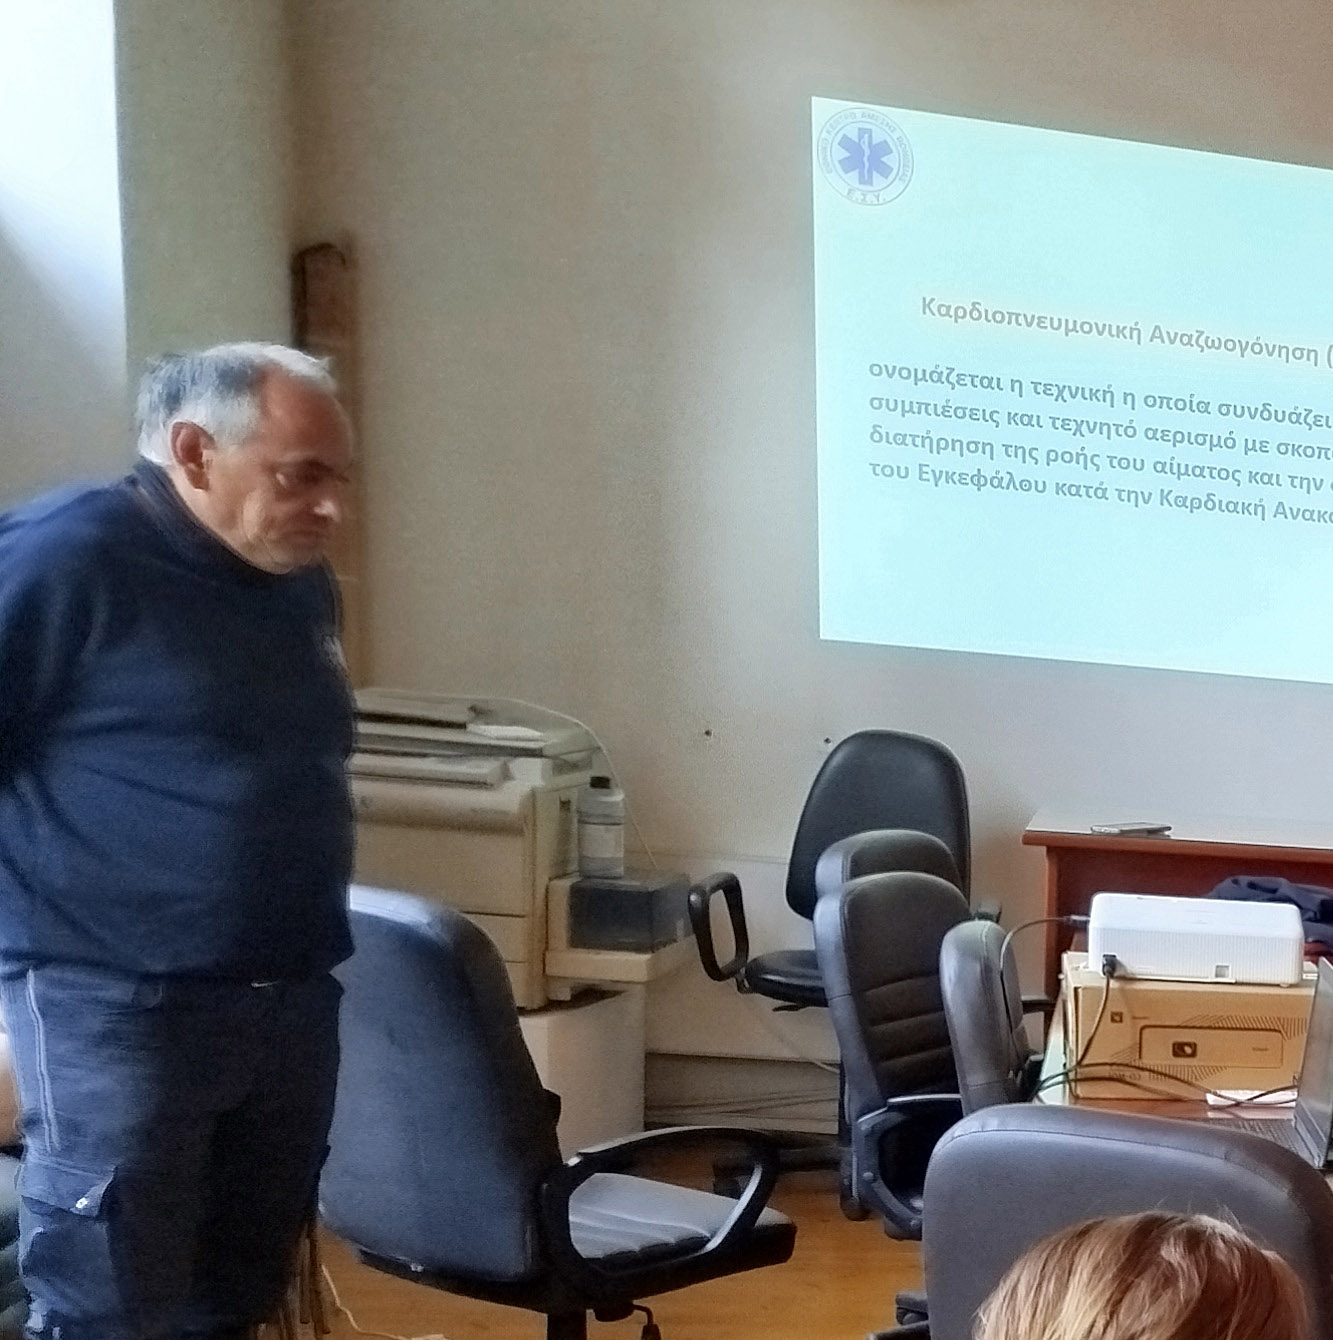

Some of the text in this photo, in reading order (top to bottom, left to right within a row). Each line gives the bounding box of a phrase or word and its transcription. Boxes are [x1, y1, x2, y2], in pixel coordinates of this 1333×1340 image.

[921, 296, 1142, 345] Καρδιοπνευμονική
[1149, 323, 1319, 367] Αναζωογόνηση
[868, 362, 1004, 391] ονομάζεται
[1010, 377, 1024, 398] η
[1030, 379, 1115, 408] τεχνική
[1123, 390, 1136, 411] η
[1143, 392, 1212, 415] οποία
[1217, 402, 1332, 431] συνδυάζει
[869, 395, 1000, 428] συμπιέσεις
[1006, 409, 1044, 428] και
[1049, 413, 1137, 441] τεχνητό
[1144, 426, 1237, 452] αερισμό
[1244, 437, 1270, 456] με
[868, 461, 910, 480] του
[917, 462, 1047, 494] Εγκεφάλου
[1055, 480, 1110, 501] κατά
[1114, 486, 1154, 508] την
[1159, 488, 1266, 521] Καρδιακή
[869, 424, 995, 461] διατήρηση
[1001, 441, 1039, 464] της
[1045, 446, 1100, 472] ροής
[1106, 453, 1145, 472] του
[1152, 457, 1242, 487] αίματος
[1248, 470, 1283, 488] και
[1287, 473, 1324, 495] την
